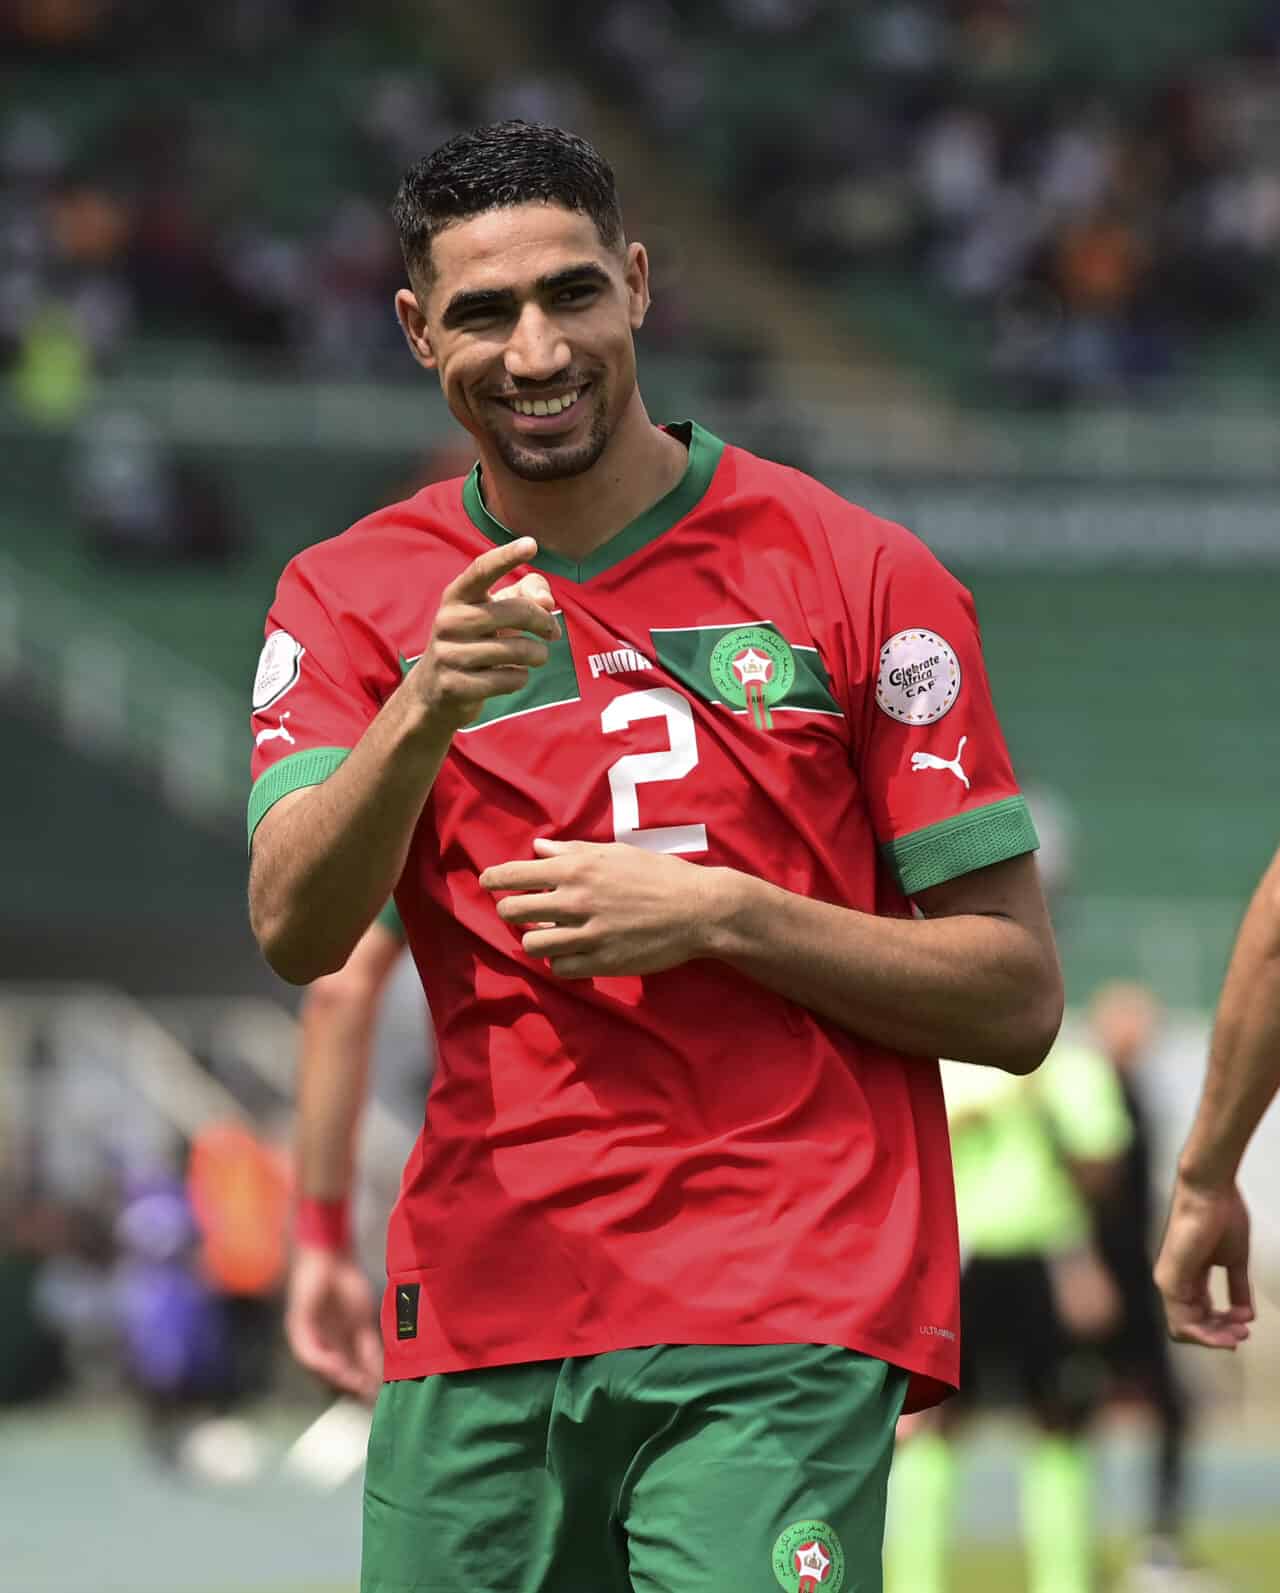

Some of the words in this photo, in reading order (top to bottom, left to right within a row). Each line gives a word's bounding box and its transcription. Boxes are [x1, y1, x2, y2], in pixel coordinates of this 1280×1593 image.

[587, 647, 654, 679] PUMA
[905, 680, 936, 698] CAF
[600, 686, 709, 855] 2
